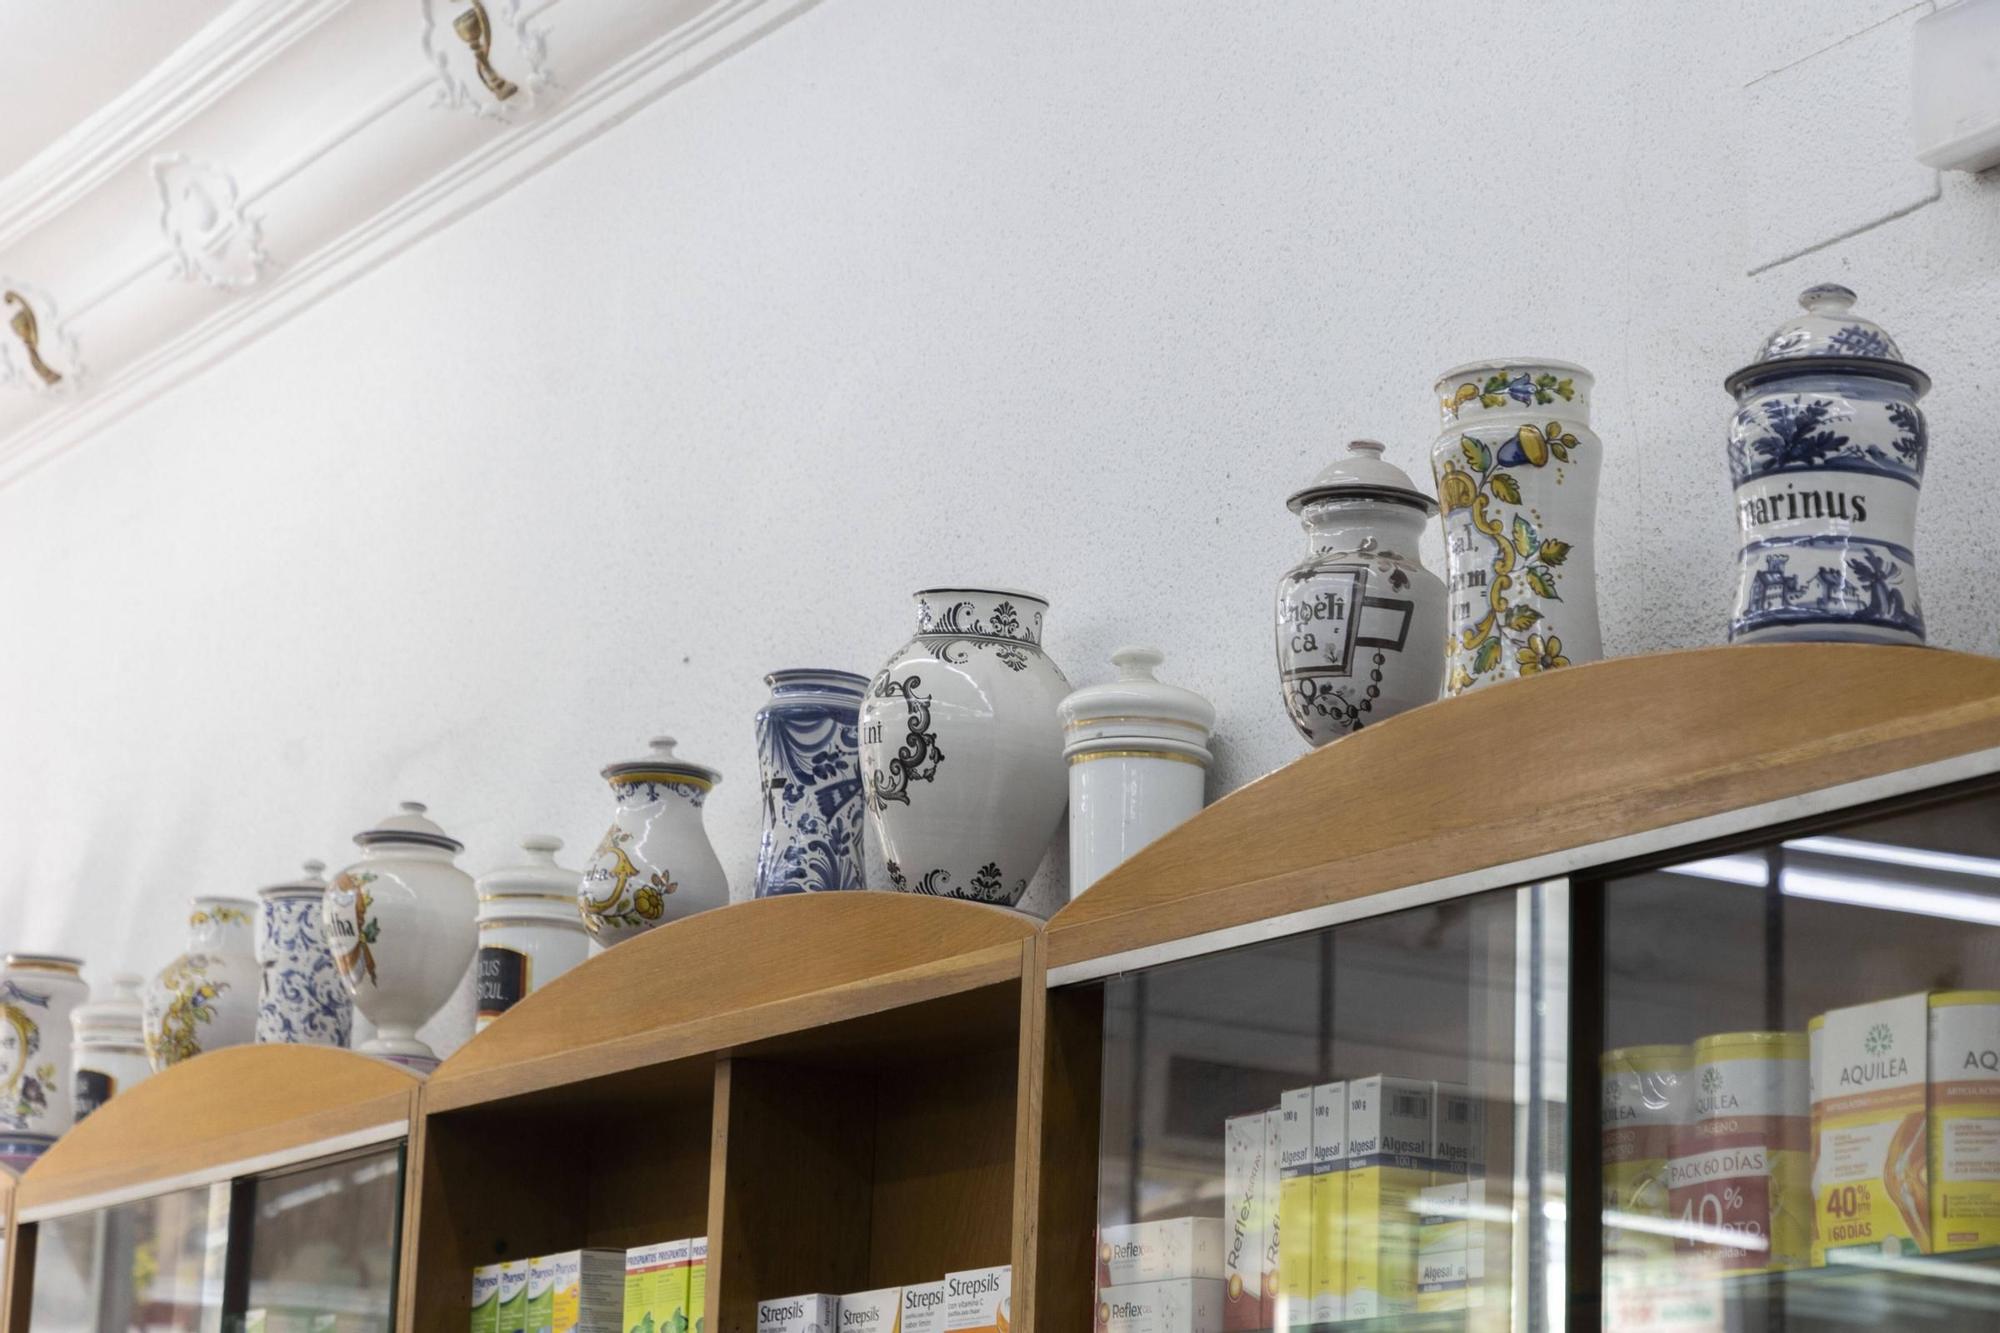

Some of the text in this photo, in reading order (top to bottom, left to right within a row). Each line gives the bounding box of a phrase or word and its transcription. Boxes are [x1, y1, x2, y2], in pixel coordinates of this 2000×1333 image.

[1840, 1058, 1908, 1086] AQUILEA
[1315, 1143, 1340, 1160] Algesal
[1350, 1138, 1376, 1155] Algesal
[1382, 1136, 1424, 1153] Algesal
[1281, 1148, 1308, 1164] Algesal
[1672, 1152, 1763, 1182] PACK 60 DÍAS
[1227, 1191, 1254, 1269] Reflex
[1113, 1241, 1143, 1259] Reflex
[949, 1272, 1000, 1298] Strepsils
[760, 1301, 804, 1326] Strepsils
[843, 1305, 880, 1327] Strepsils
[1112, 1302, 1143, 1319] Reflex
